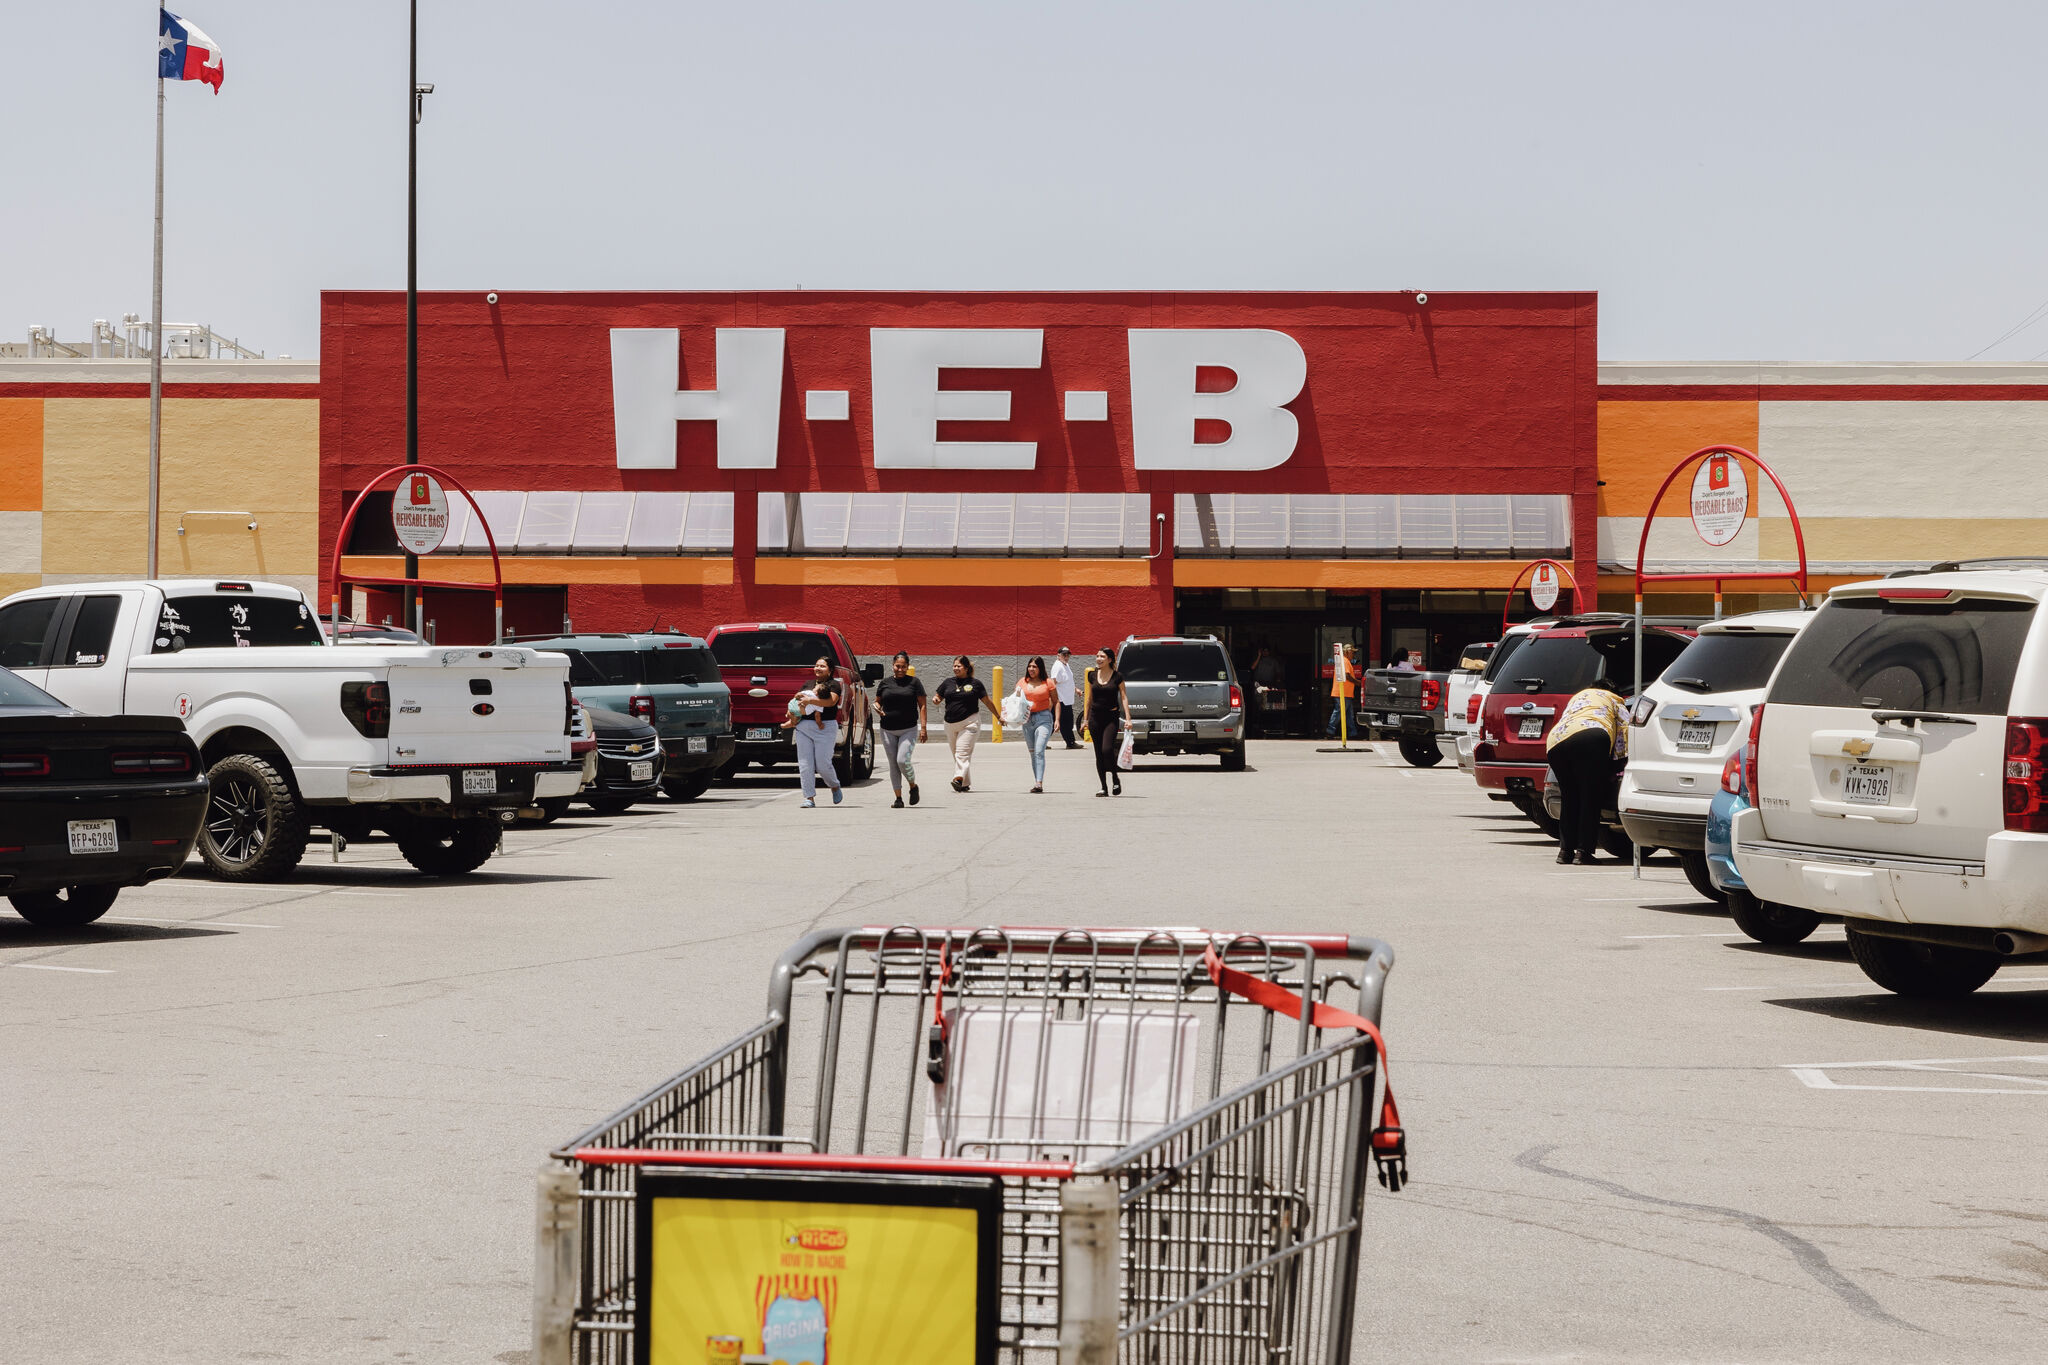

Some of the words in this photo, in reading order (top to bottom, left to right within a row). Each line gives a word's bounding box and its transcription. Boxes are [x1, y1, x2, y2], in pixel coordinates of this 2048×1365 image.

[610, 328, 1307, 471] H-E-B
[1695, 498, 1725, 516] REUSABLE
[1727, 497, 1744, 513] BAGS
[396, 513, 427, 527] REUSABLE
[428, 514, 445, 528] BAGS
[1860, 767, 1878, 775] TEXAS
[780, 1253, 801, 1267] HOW
[804, 1254, 814, 1268] TO
